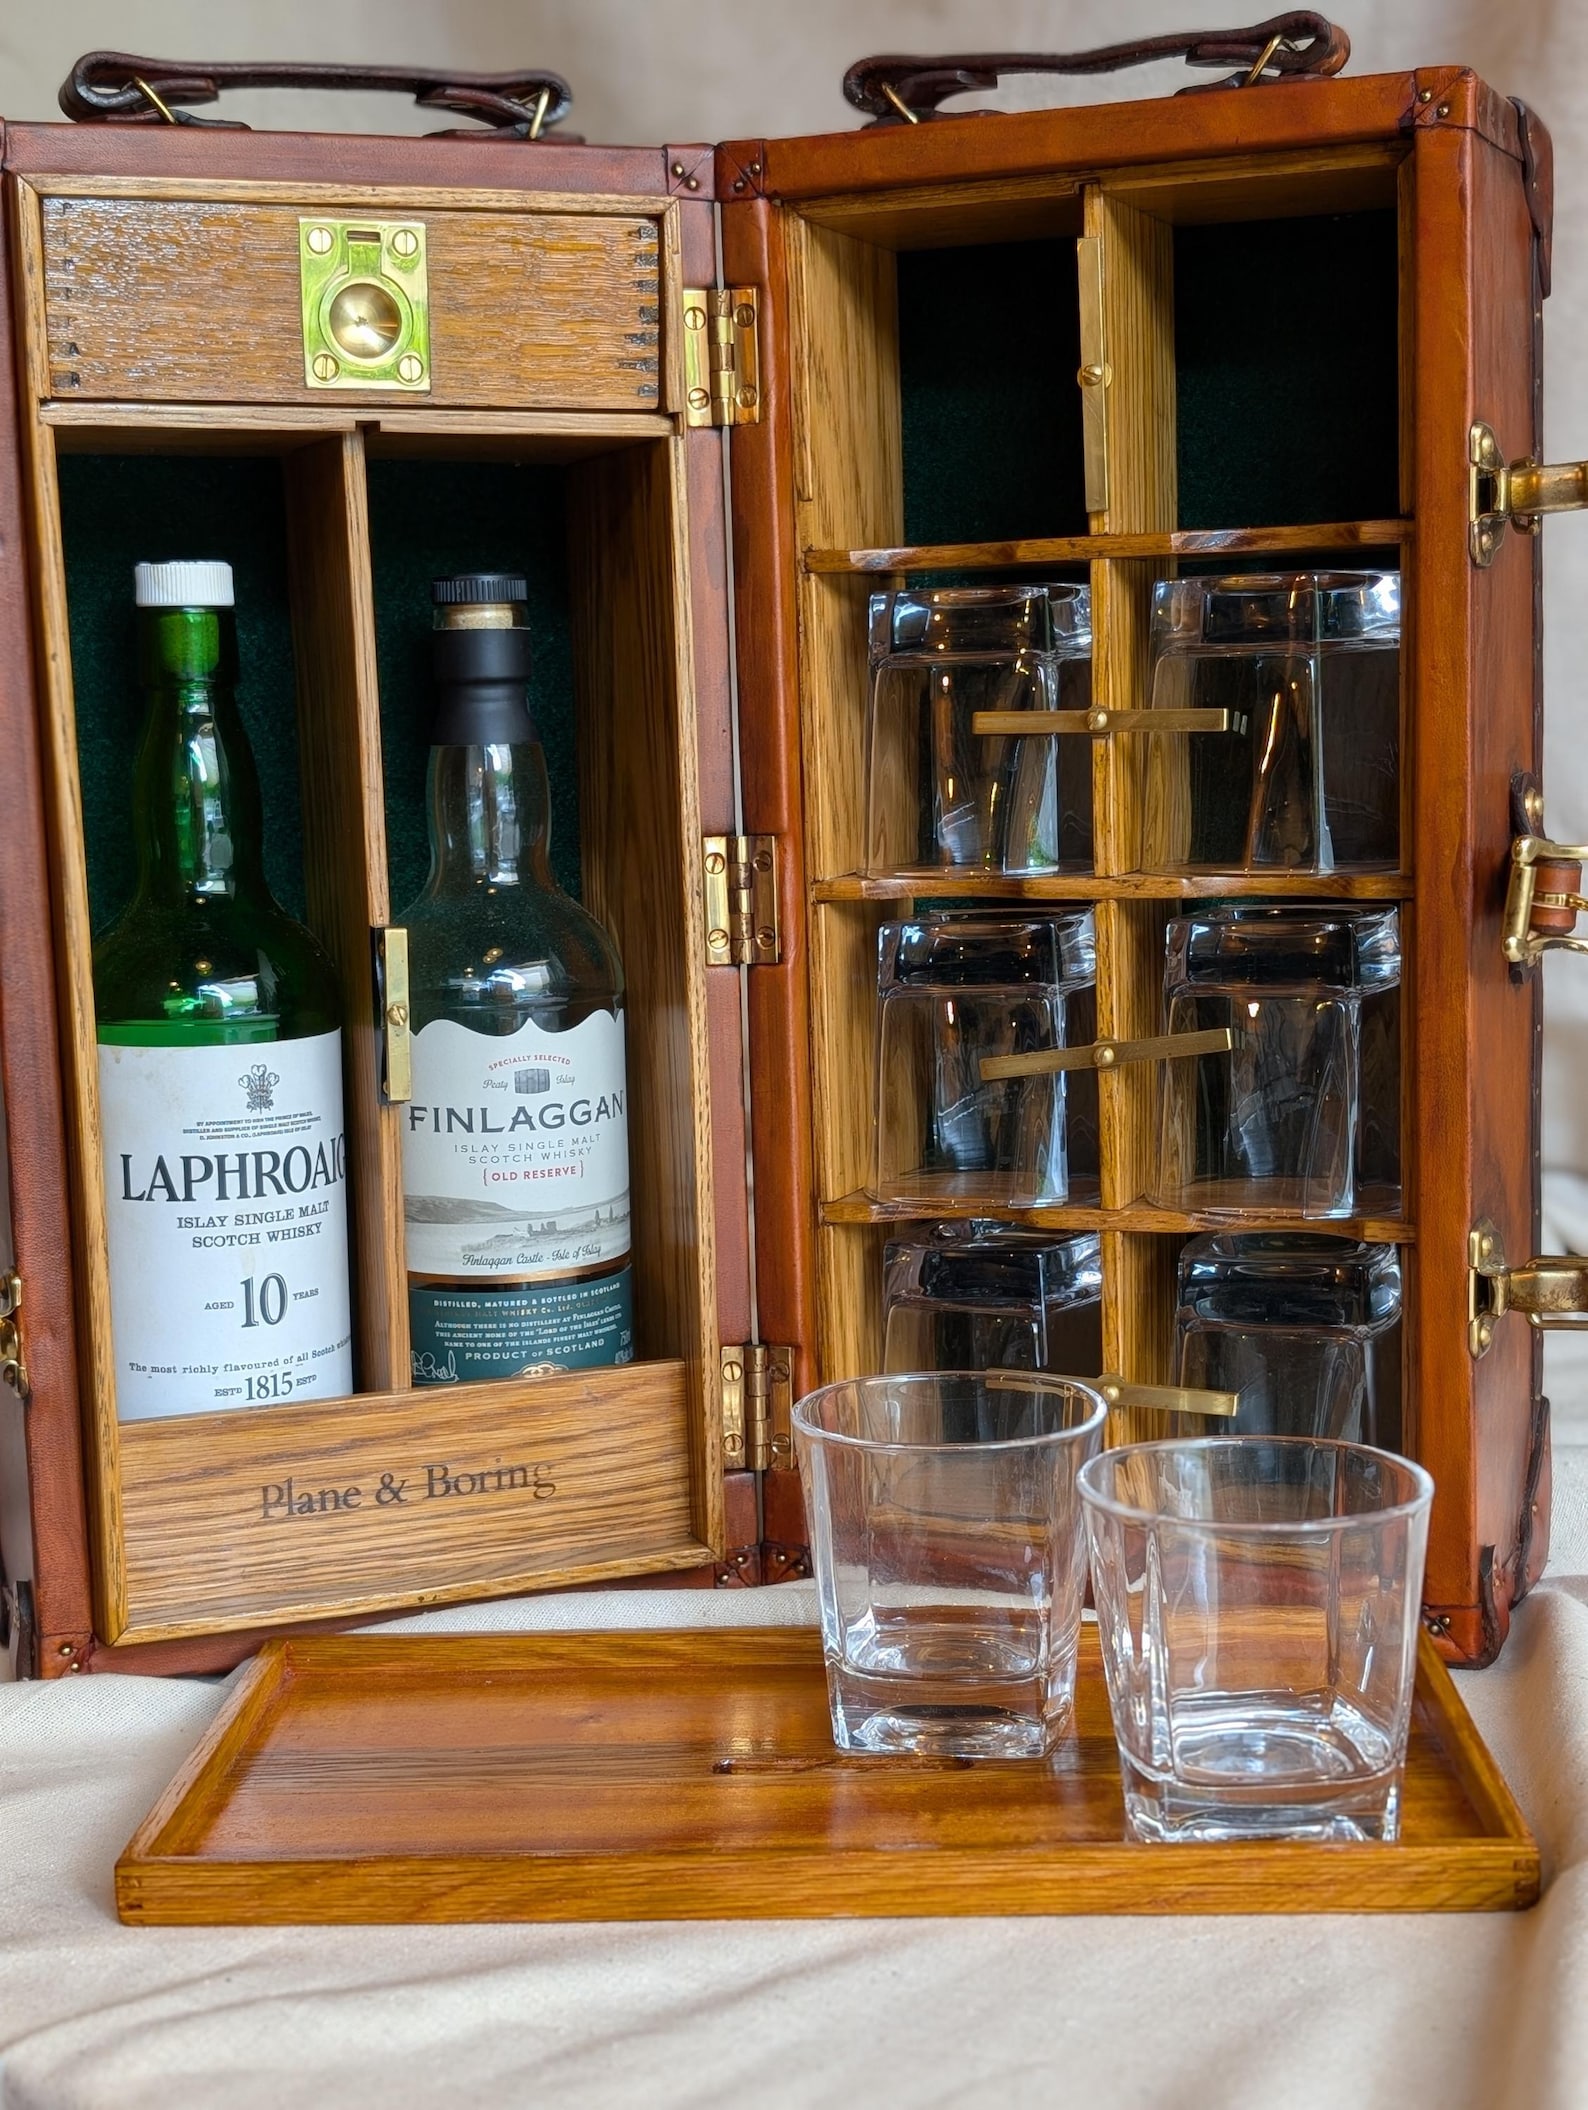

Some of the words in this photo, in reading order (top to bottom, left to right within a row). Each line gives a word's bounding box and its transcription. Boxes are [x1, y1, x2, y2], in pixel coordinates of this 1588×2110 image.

[488, 1055, 531, 1071] SPECIALLY
[534, 1054, 571, 1065] SELECTED
[482, 1079, 508, 1091] Peaty
[409, 1090, 624, 1133] FINLAGGAN
[454, 1143, 499, 1154] ISLAY
[508, 1139, 564, 1151] SINGLE
[571, 1133, 601, 1146] MALT
[468, 1155, 532, 1165] SCOTCH
[541, 1146, 592, 1161] WHISKY
[177, 1215, 229, 1229] ISLAY
[234, 1209, 295, 1226] SINGLE
[299, 1200, 330, 1218] MALT
[192, 1233, 262, 1249] SCOTCH
[266, 1221, 323, 1243] WHISKY
[462, 1254, 513, 1269] Finlaggan
[516, 1252, 543, 1265] Castle
[572, 1247, 581, 1260] of
[204, 1301, 234, 1311] AGED
[240, 1272, 289, 1329] 10
[292, 1288, 320, 1301] YEARS
[434, 1300, 481, 1309] DISTILLED,
[484, 1299, 529, 1308] MATURED
[541, 1294, 577, 1304] BOTTLED
[579, 1291, 589, 1299] IN
[591, 1283, 620, 1297] SCOTLAND
[128, 1362, 148, 1373] The
[150, 1365, 178, 1374] most
[182, 1364, 219, 1375] richly
[223, 1358, 280, 1373] flavoured
[283, 1355, 294, 1365] of
[296, 1352, 309, 1363] all
[311, 1344, 335, 1359] Scotch
[465, 1350, 528, 1361] PRODUCT
[547, 1339, 604, 1356] SCOTLAND
[214, 1388, 242, 1398] ESTD
[244, 1371, 294, 1401] 1815
[295, 1374, 318, 1387] ESTD
[260, 1477, 362, 1519] Plane
[375, 1473, 409, 1506] &
[423, 1458, 556, 1500] Boring
